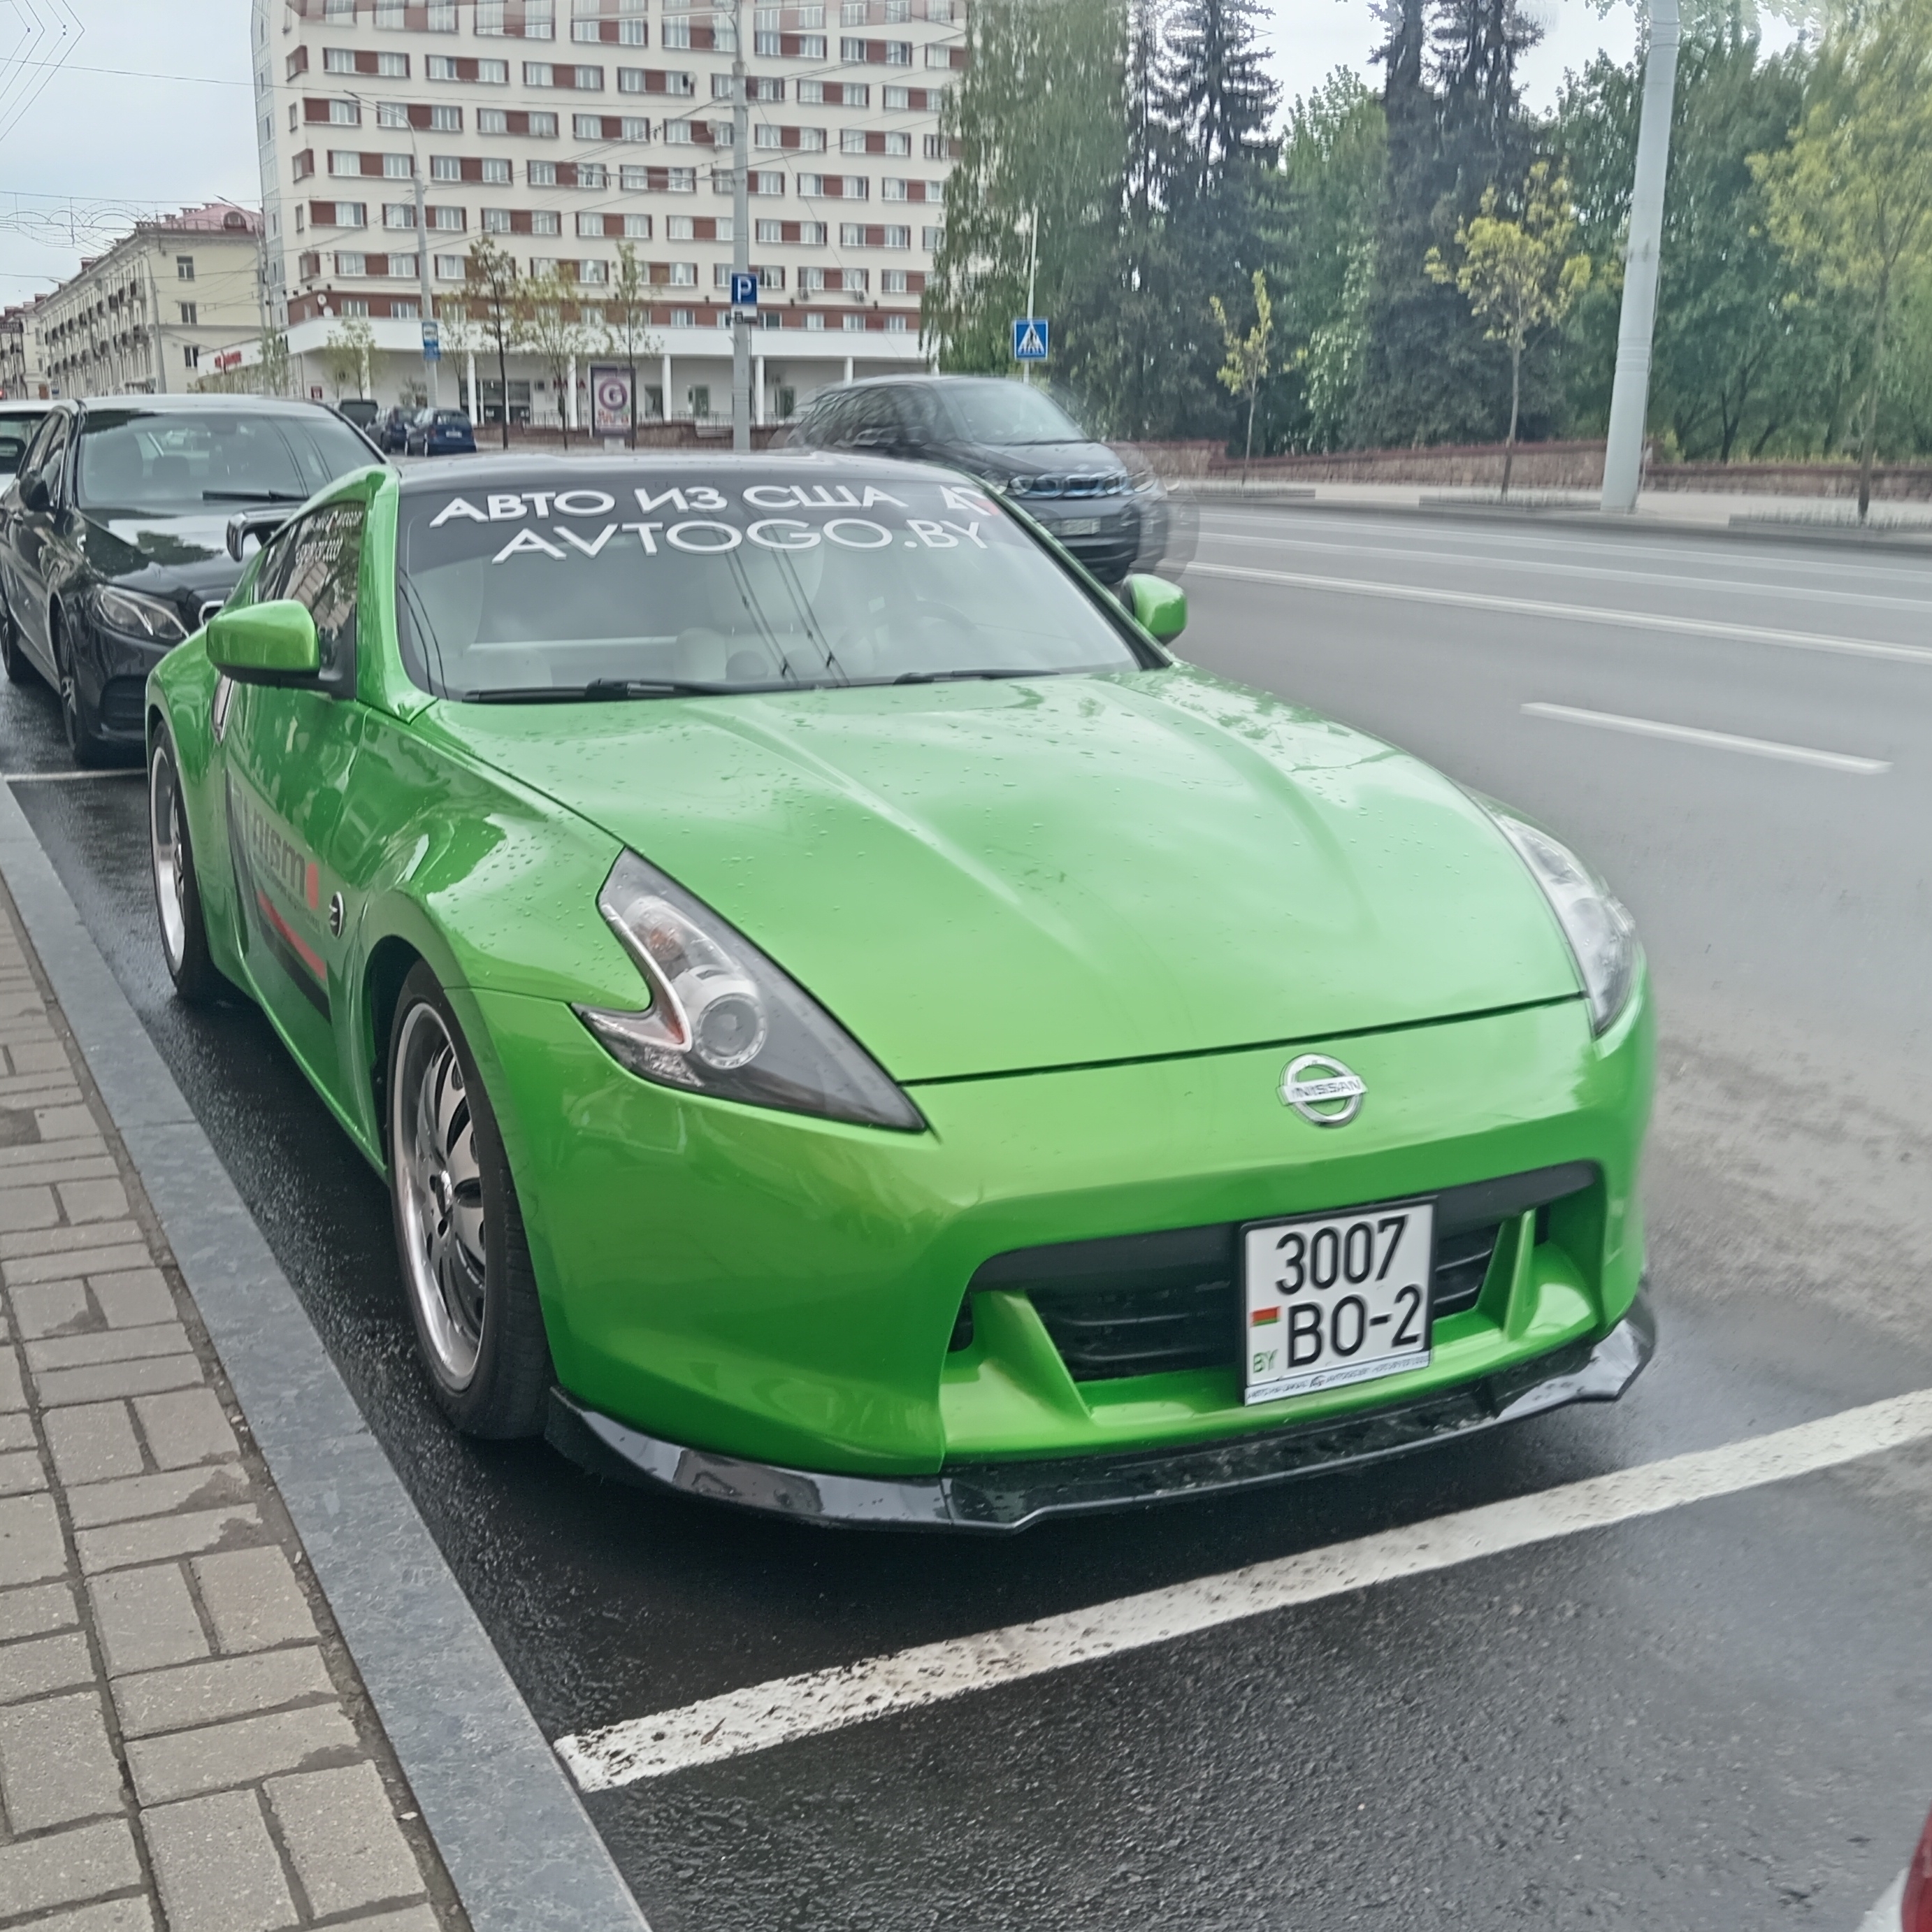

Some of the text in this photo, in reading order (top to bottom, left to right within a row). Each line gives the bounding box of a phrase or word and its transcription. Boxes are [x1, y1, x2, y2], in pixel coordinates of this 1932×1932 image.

[737, 276, 751, 303] P
[429, 484, 908, 528] АВТО ИЗ США
[491, 517, 989, 564] AVTOGO.BY
[1293, 1079, 1362, 1097] NISSAN
[1276, 1213, 1408, 1295] 3007
[1288, 1283, 1423, 1368] BO-2
[1253, 1349, 1278, 1374] BY
